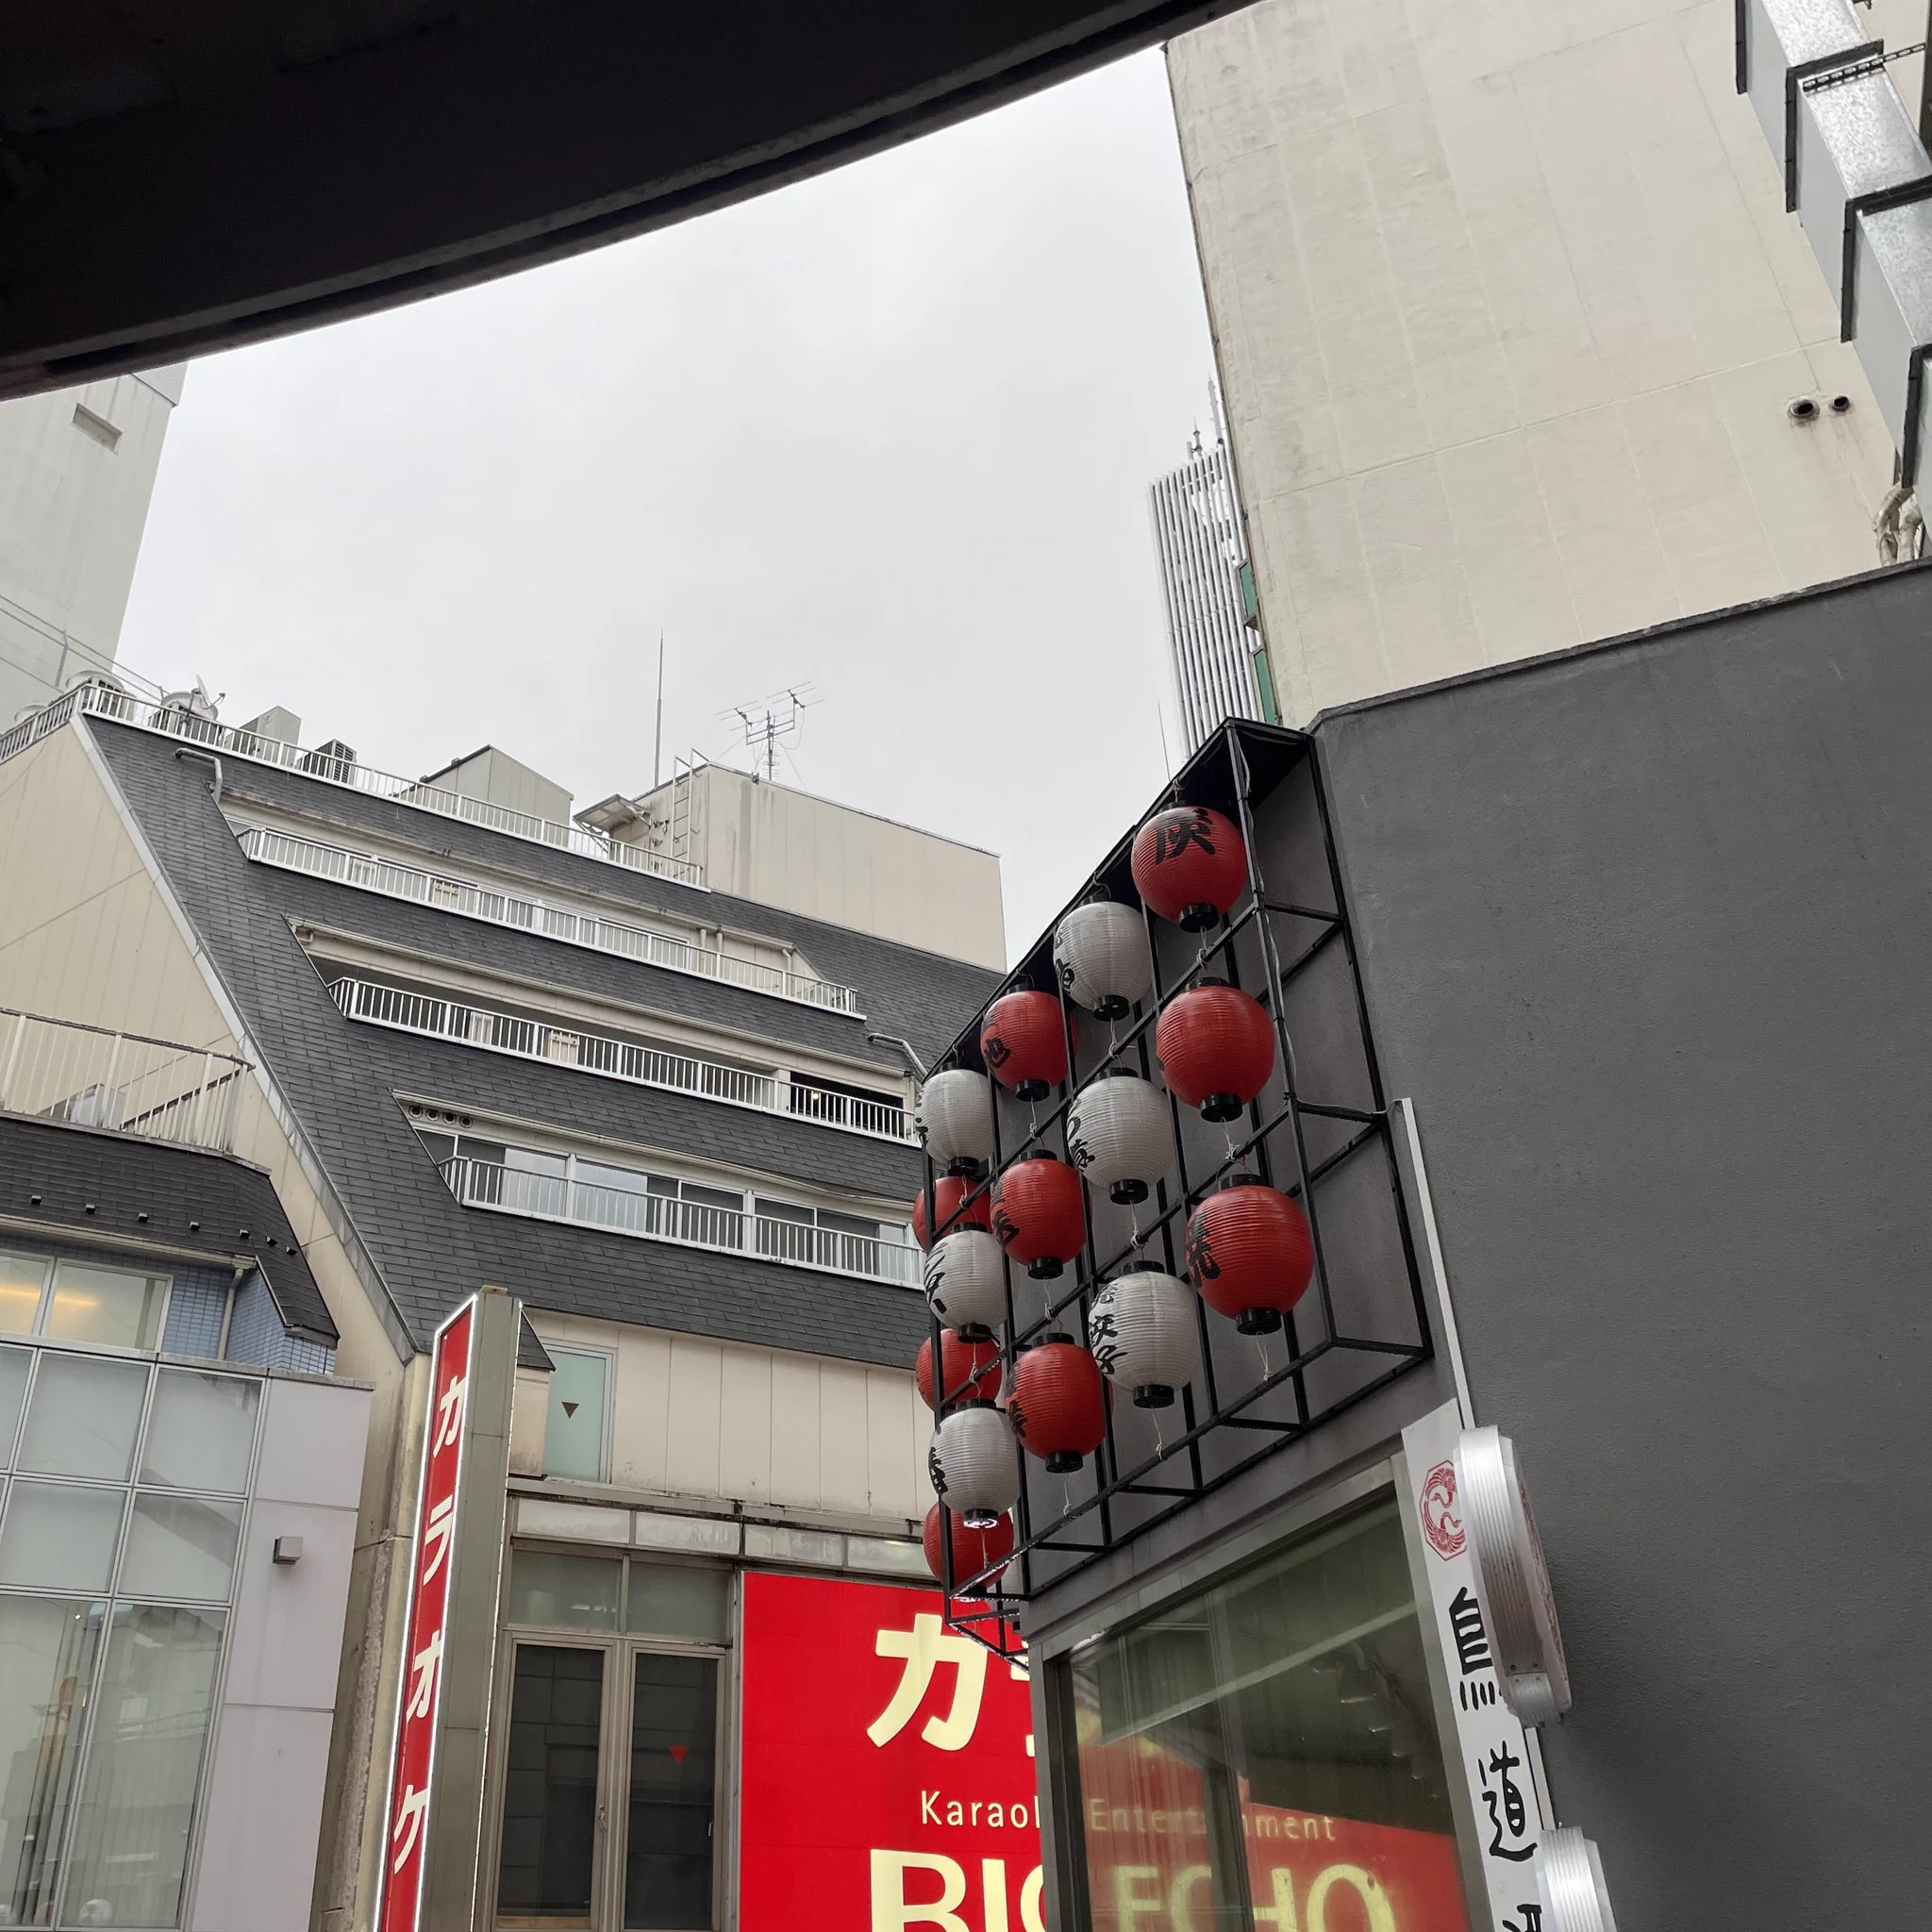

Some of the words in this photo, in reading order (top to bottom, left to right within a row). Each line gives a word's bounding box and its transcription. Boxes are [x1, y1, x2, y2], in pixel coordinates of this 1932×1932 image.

[393, 1374, 466, 1876] カラオケ
[866, 1612, 1036, 1757] カ
[870, 1848, 1047, 1932] BI
